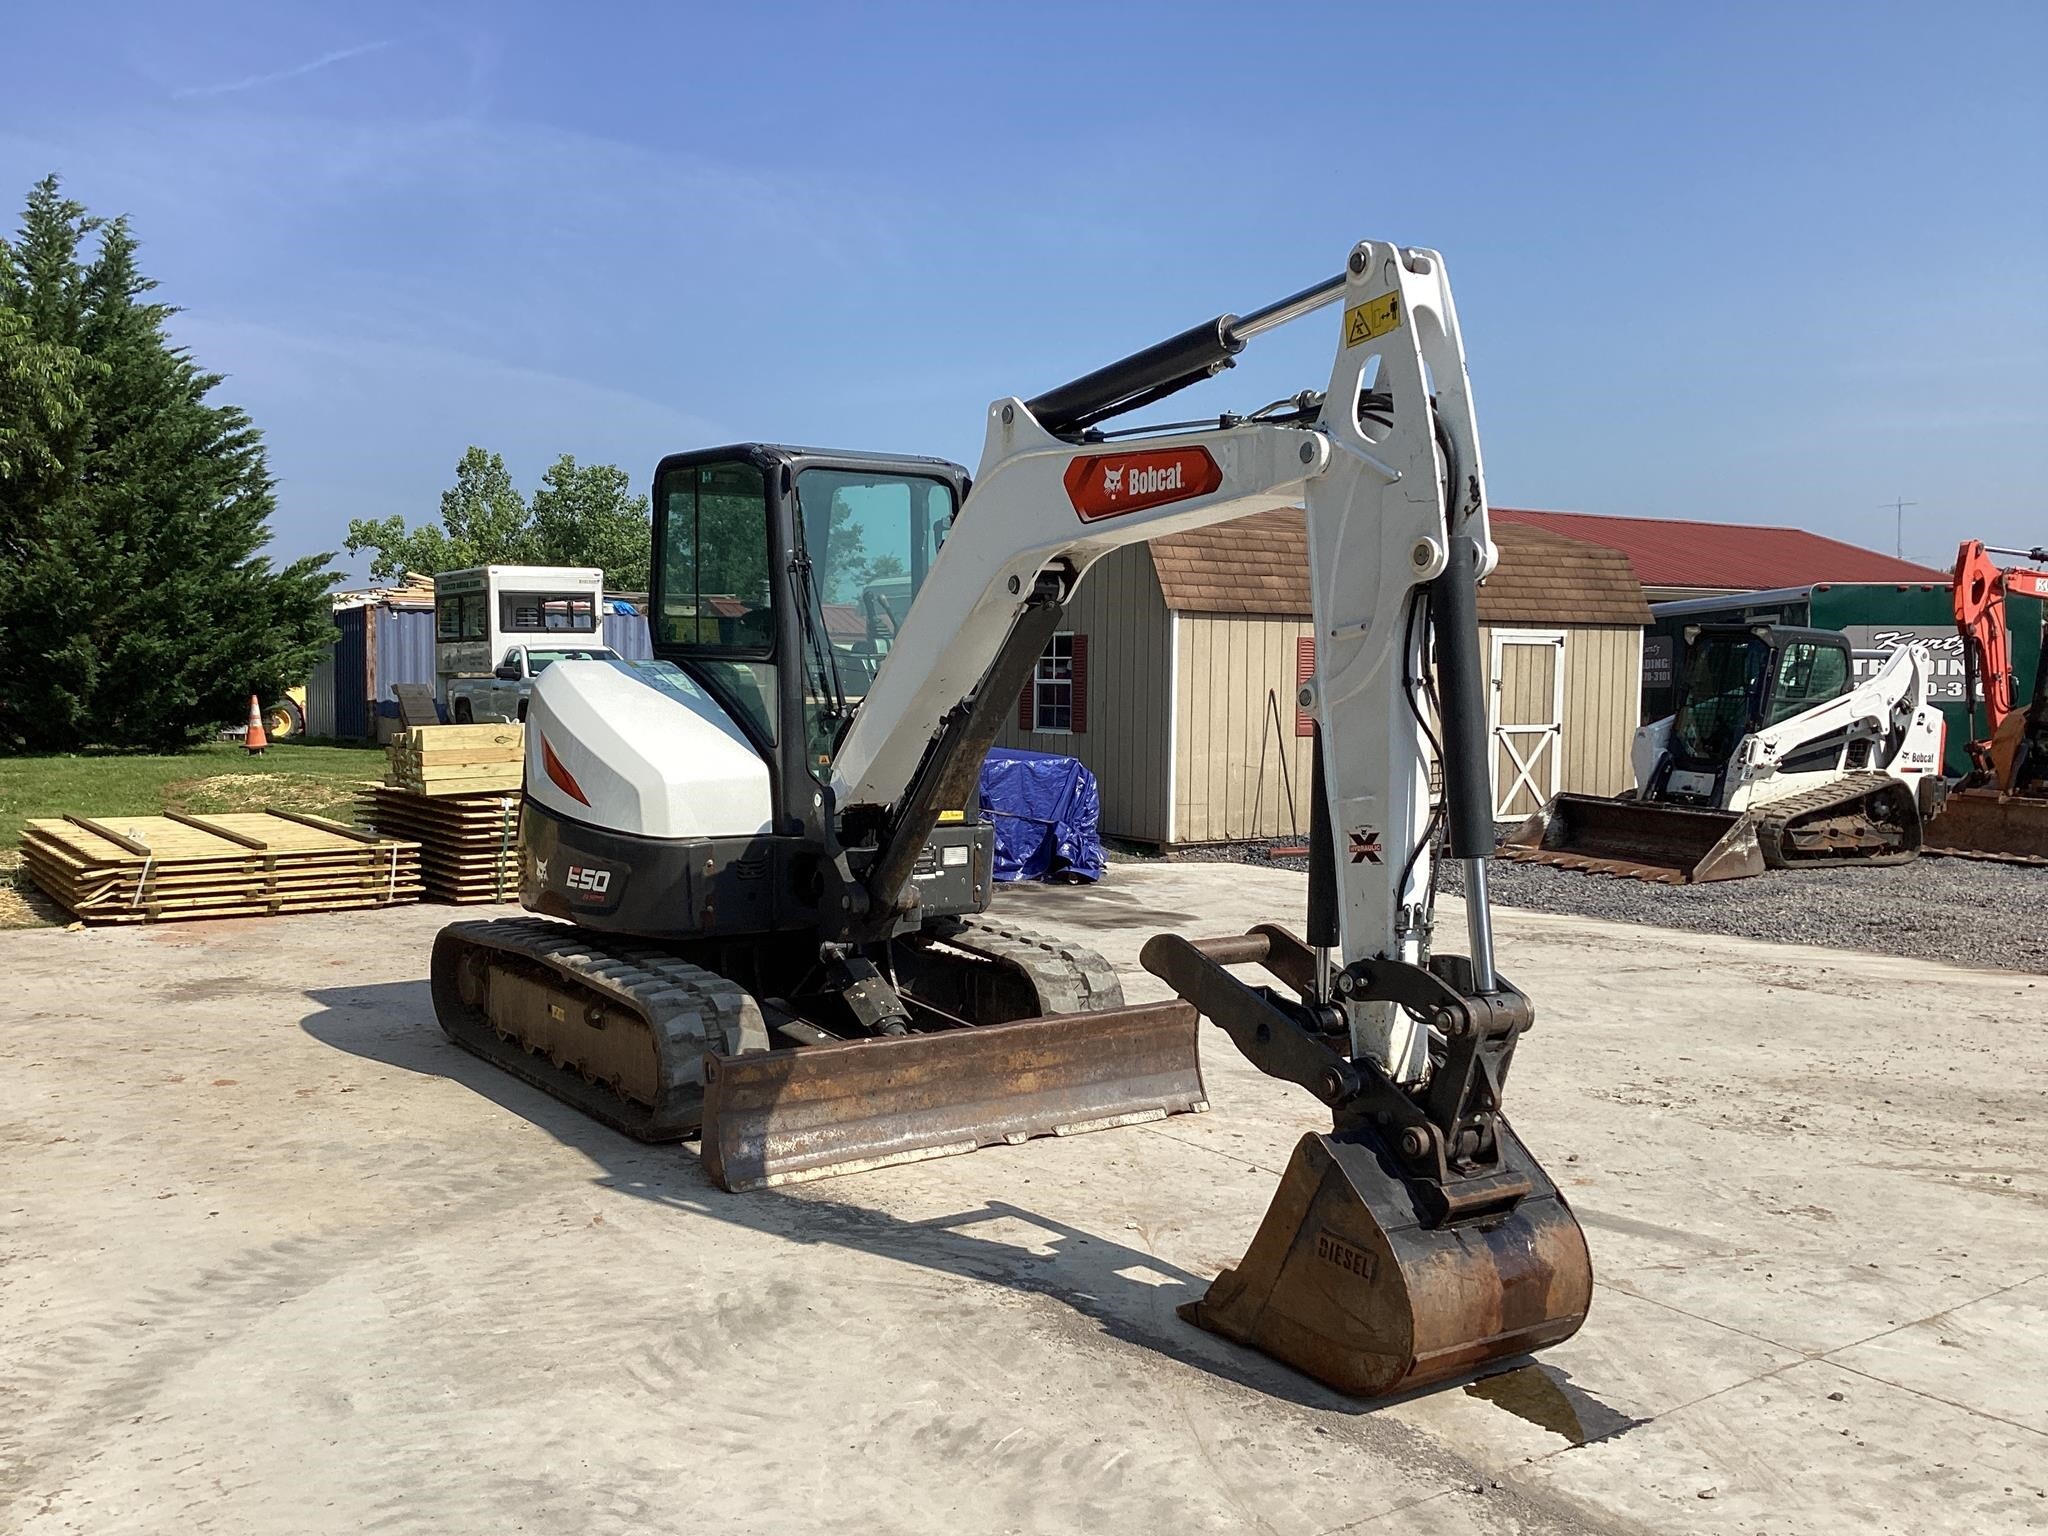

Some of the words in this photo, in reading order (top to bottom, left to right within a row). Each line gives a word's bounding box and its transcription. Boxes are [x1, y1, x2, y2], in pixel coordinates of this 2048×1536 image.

[1129, 462, 1182, 496] Bobcat
[1916, 712, 1926, 726] 2
[1911, 752, 1934, 763] Bobcat
[566, 866, 611, 893] E50
[1318, 1236, 1369, 1280] DIESEL
